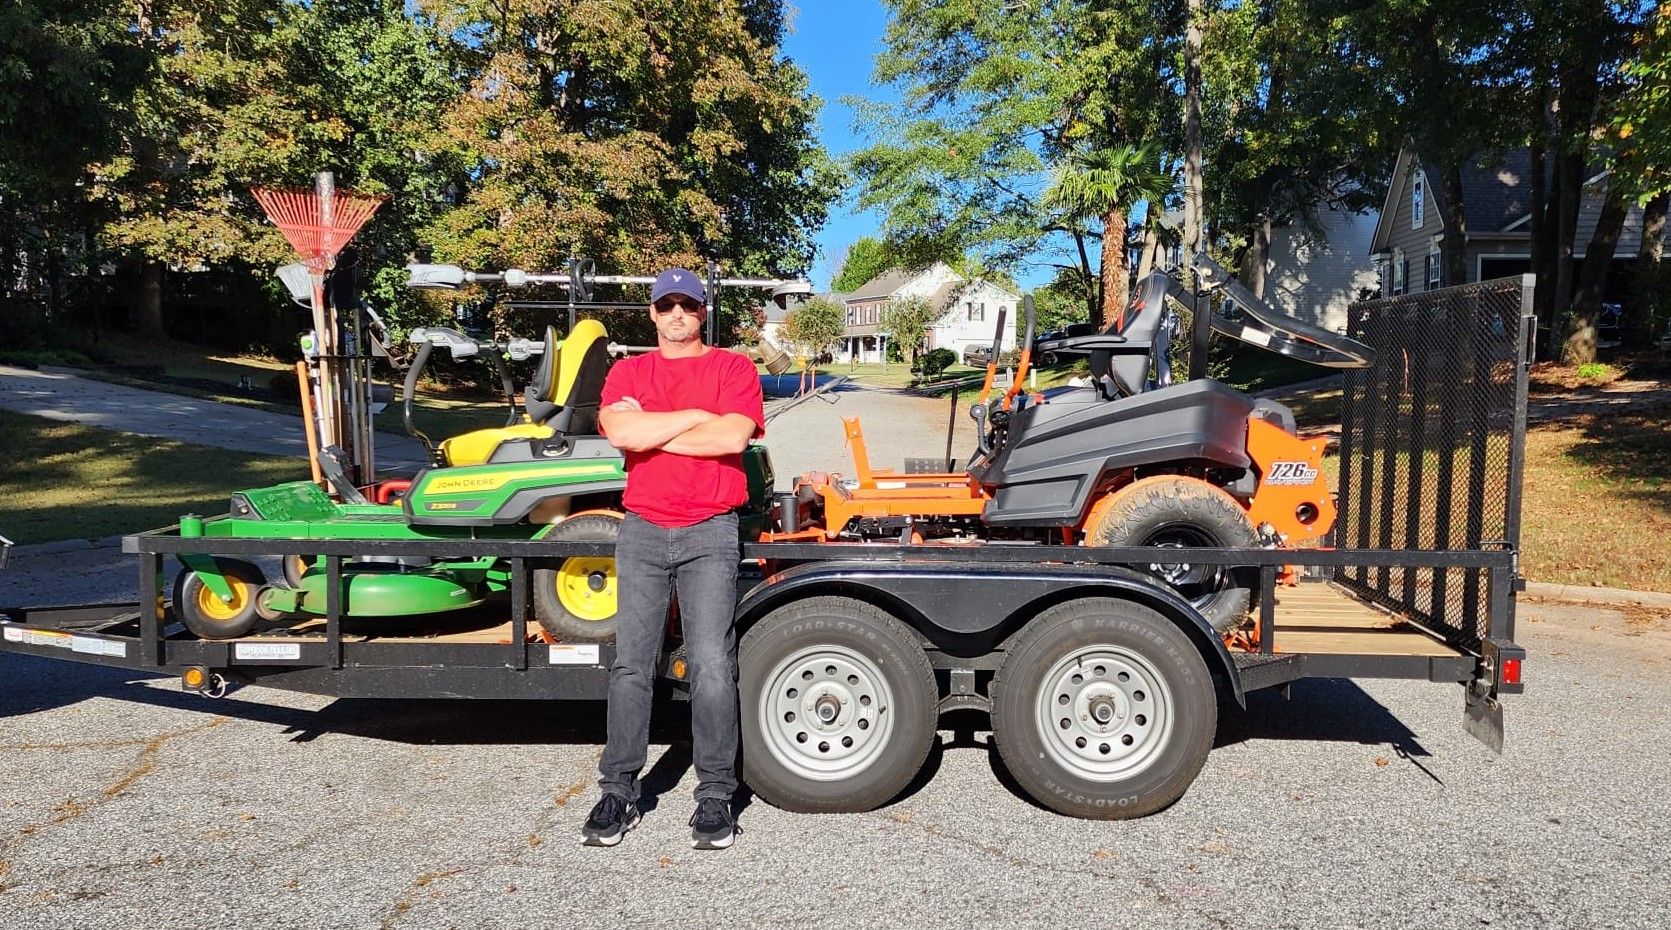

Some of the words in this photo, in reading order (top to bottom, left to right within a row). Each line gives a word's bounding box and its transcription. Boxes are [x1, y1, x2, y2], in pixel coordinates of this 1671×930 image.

[436, 480, 461, 489] JOHN
[463, 478, 495, 487] DEERE
[1095, 619, 1165, 647] KARRIER
